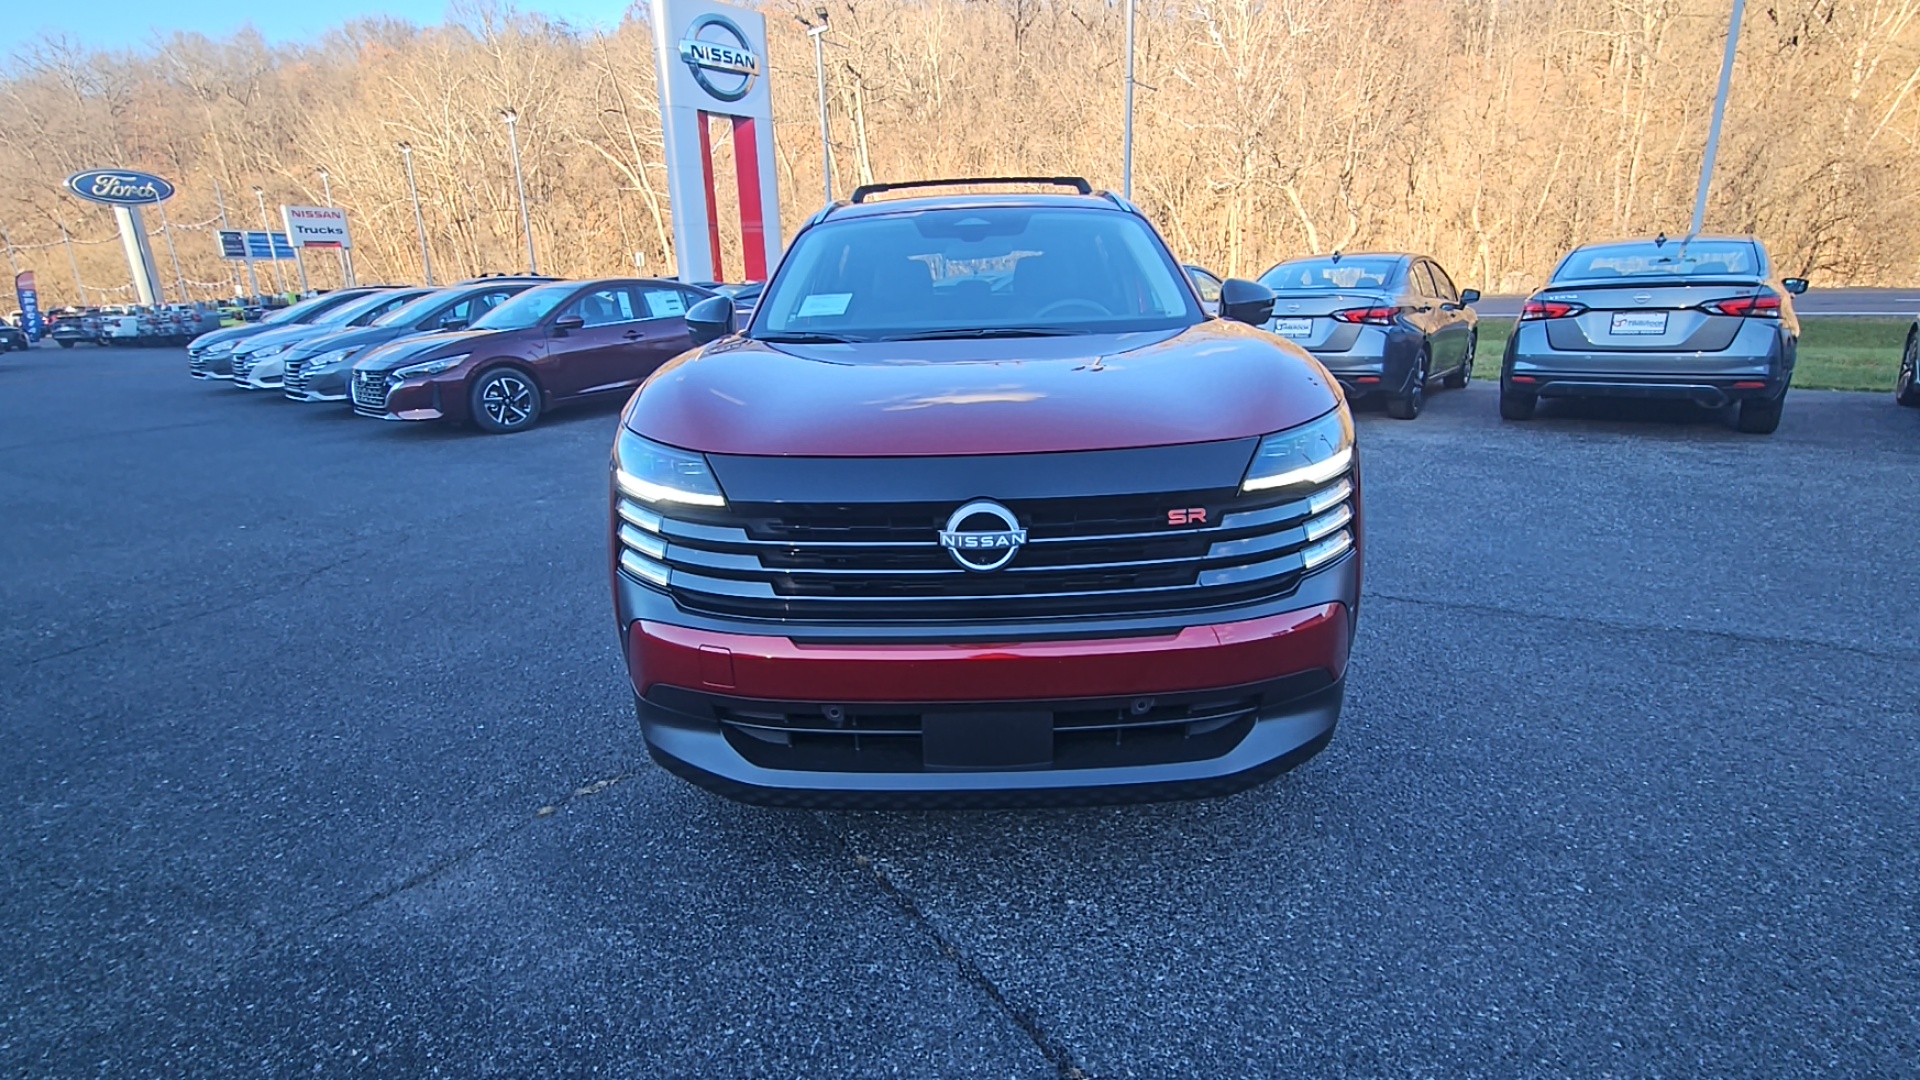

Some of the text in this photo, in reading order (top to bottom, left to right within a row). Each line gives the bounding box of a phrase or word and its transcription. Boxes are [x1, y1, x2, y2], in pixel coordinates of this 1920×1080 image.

[690, 45, 755, 70] NISSAN
[92, 174, 154, 197] Ford
[291, 209, 341, 219] NISSAN
[296, 225, 343, 235] Trucks
[1168, 507, 1207, 525] SR
[941, 533, 1025, 548] NISSAN
